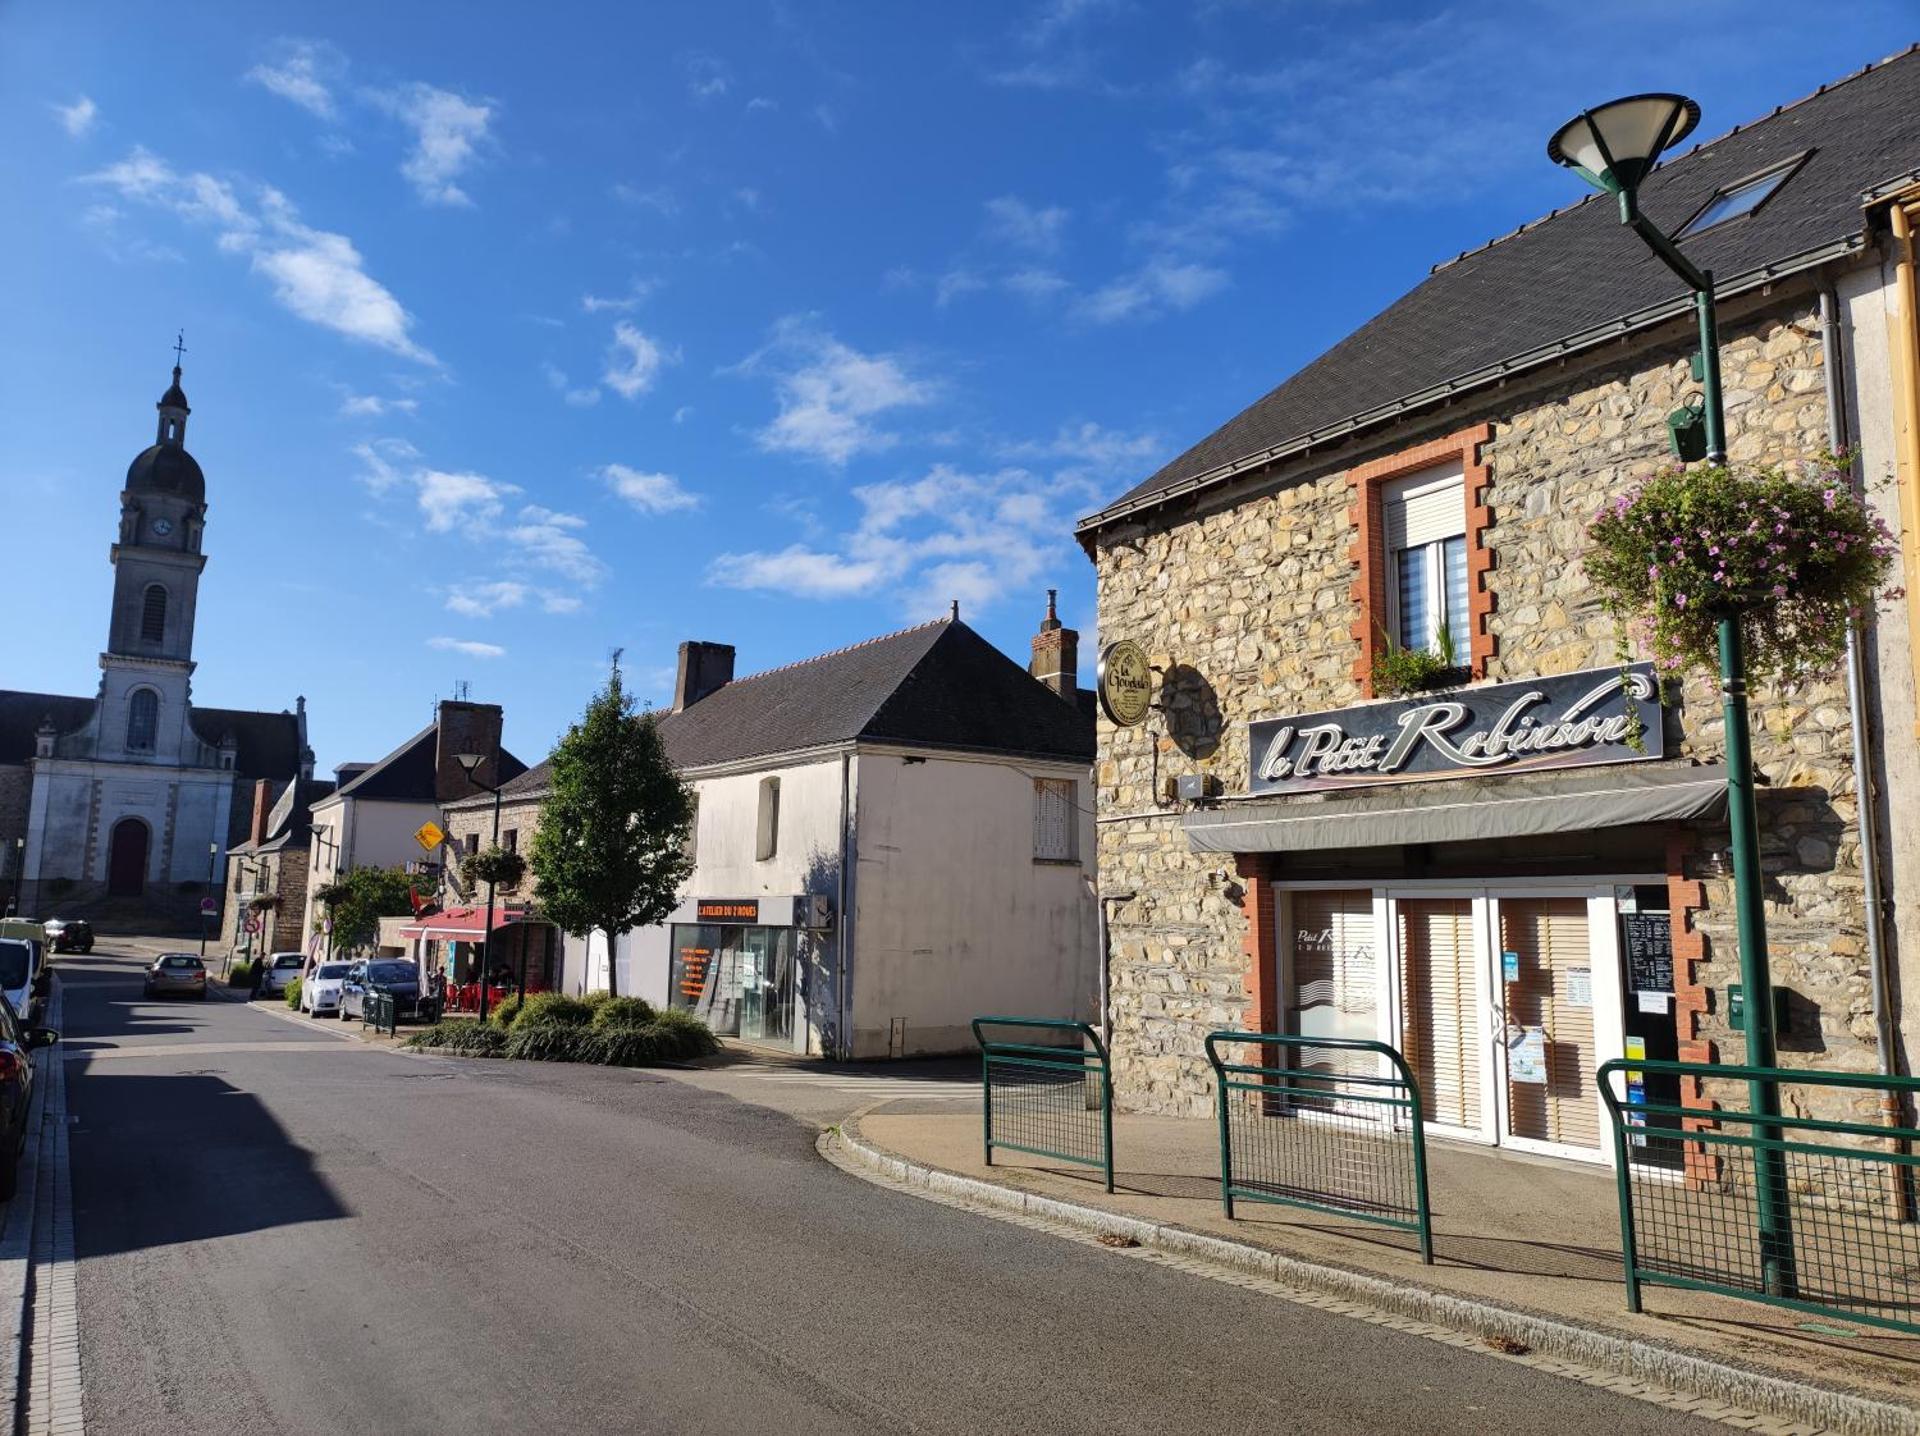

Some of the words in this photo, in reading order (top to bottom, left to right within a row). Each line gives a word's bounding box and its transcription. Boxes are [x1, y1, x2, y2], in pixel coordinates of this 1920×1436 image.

[1258, 725, 1295, 779] le
[1294, 722, 1385, 776] Petit
[1377, 672, 1654, 774] Robinson
[724, 905, 732, 917] DU
[737, 905, 757, 918] ROUES
